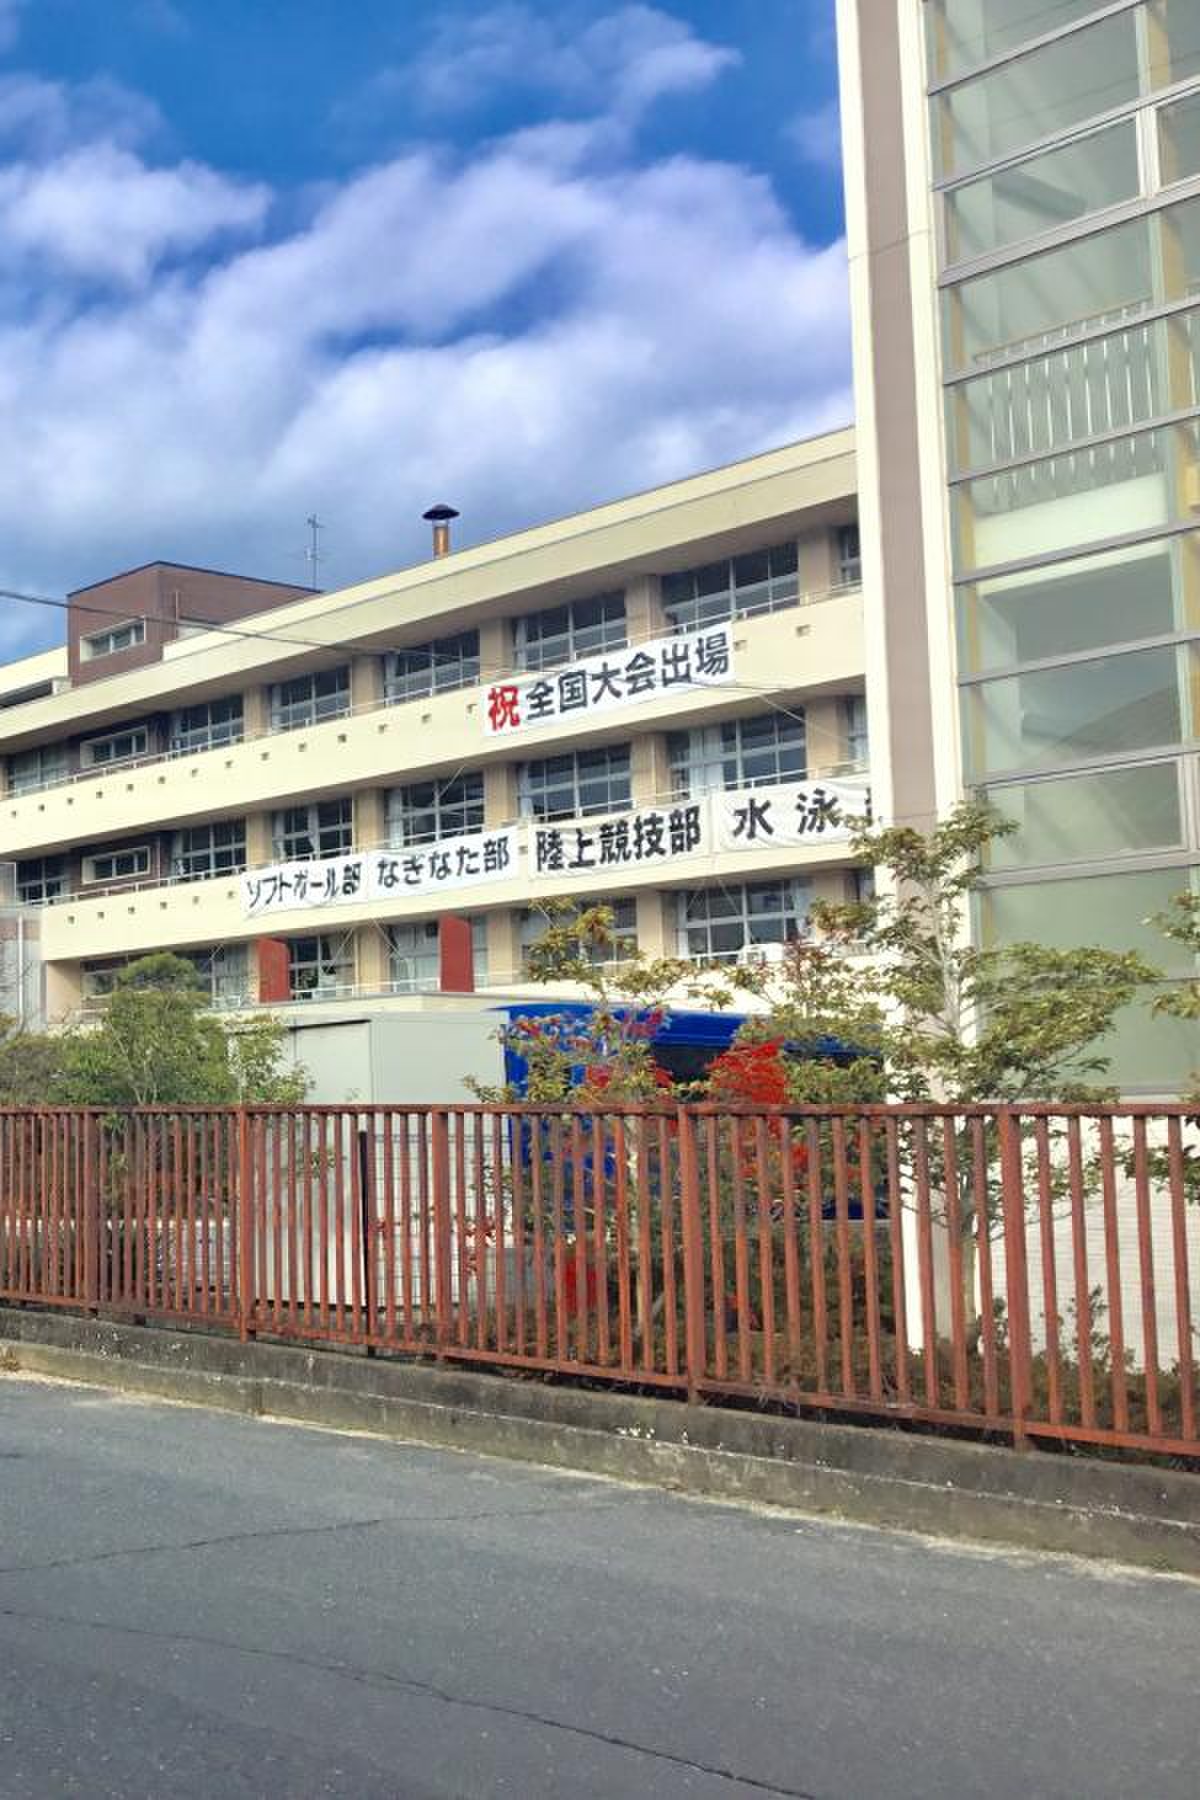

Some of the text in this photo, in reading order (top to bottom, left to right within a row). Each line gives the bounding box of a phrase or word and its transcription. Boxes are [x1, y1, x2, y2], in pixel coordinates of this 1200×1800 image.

[536, 805, 700, 872] 陸上競技部
[732, 787, 872, 840] 水泳
[377, 836, 510, 888] なぎなた部
